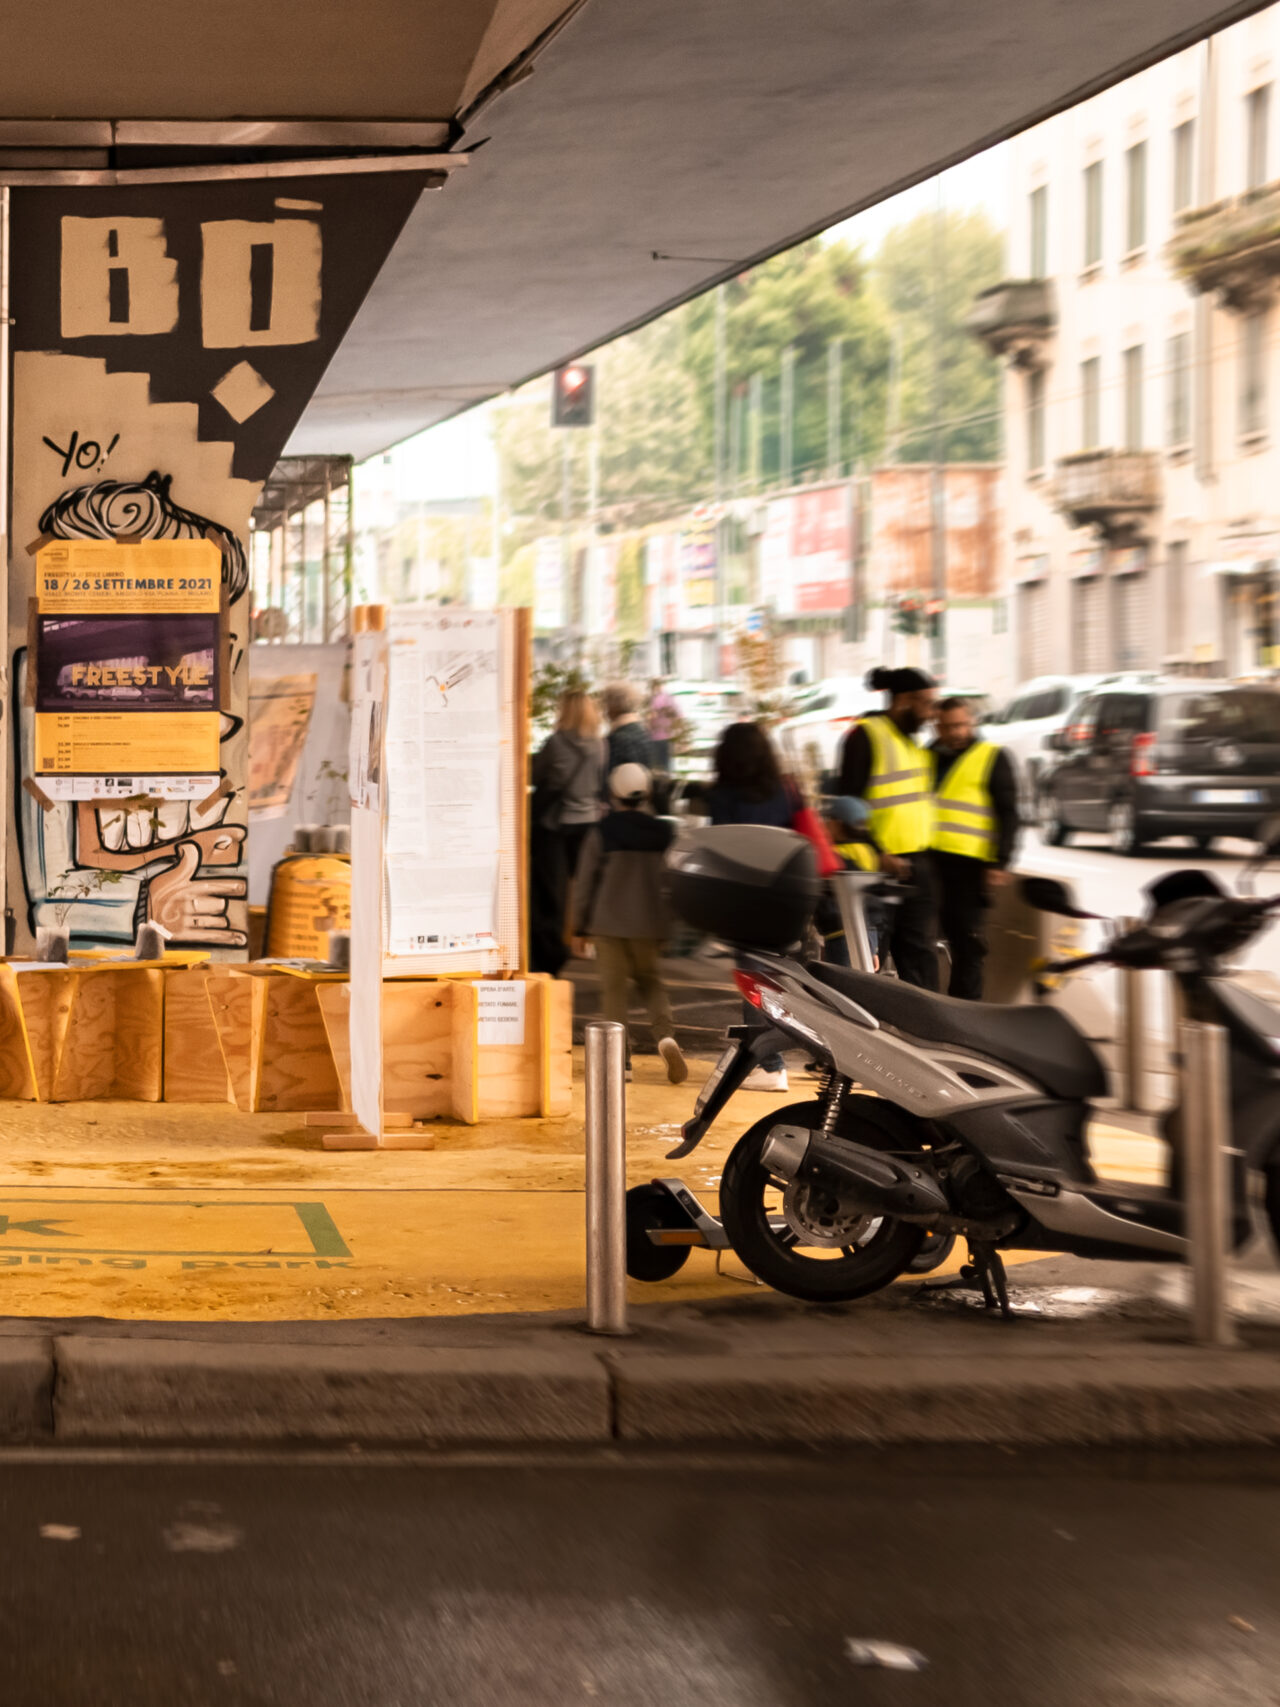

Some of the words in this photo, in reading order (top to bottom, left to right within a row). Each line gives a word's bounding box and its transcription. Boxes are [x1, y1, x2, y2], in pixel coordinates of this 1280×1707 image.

[43, 578, 59, 591] 18
[62, 578, 70, 591] /
[72, 578, 91, 590] 26
[94, 578, 174, 590] SETTEMBRE
[178, 578, 212, 590] 2021
[72, 666, 210, 687] FREESTYLE
[181, 1258, 353, 1271] park
